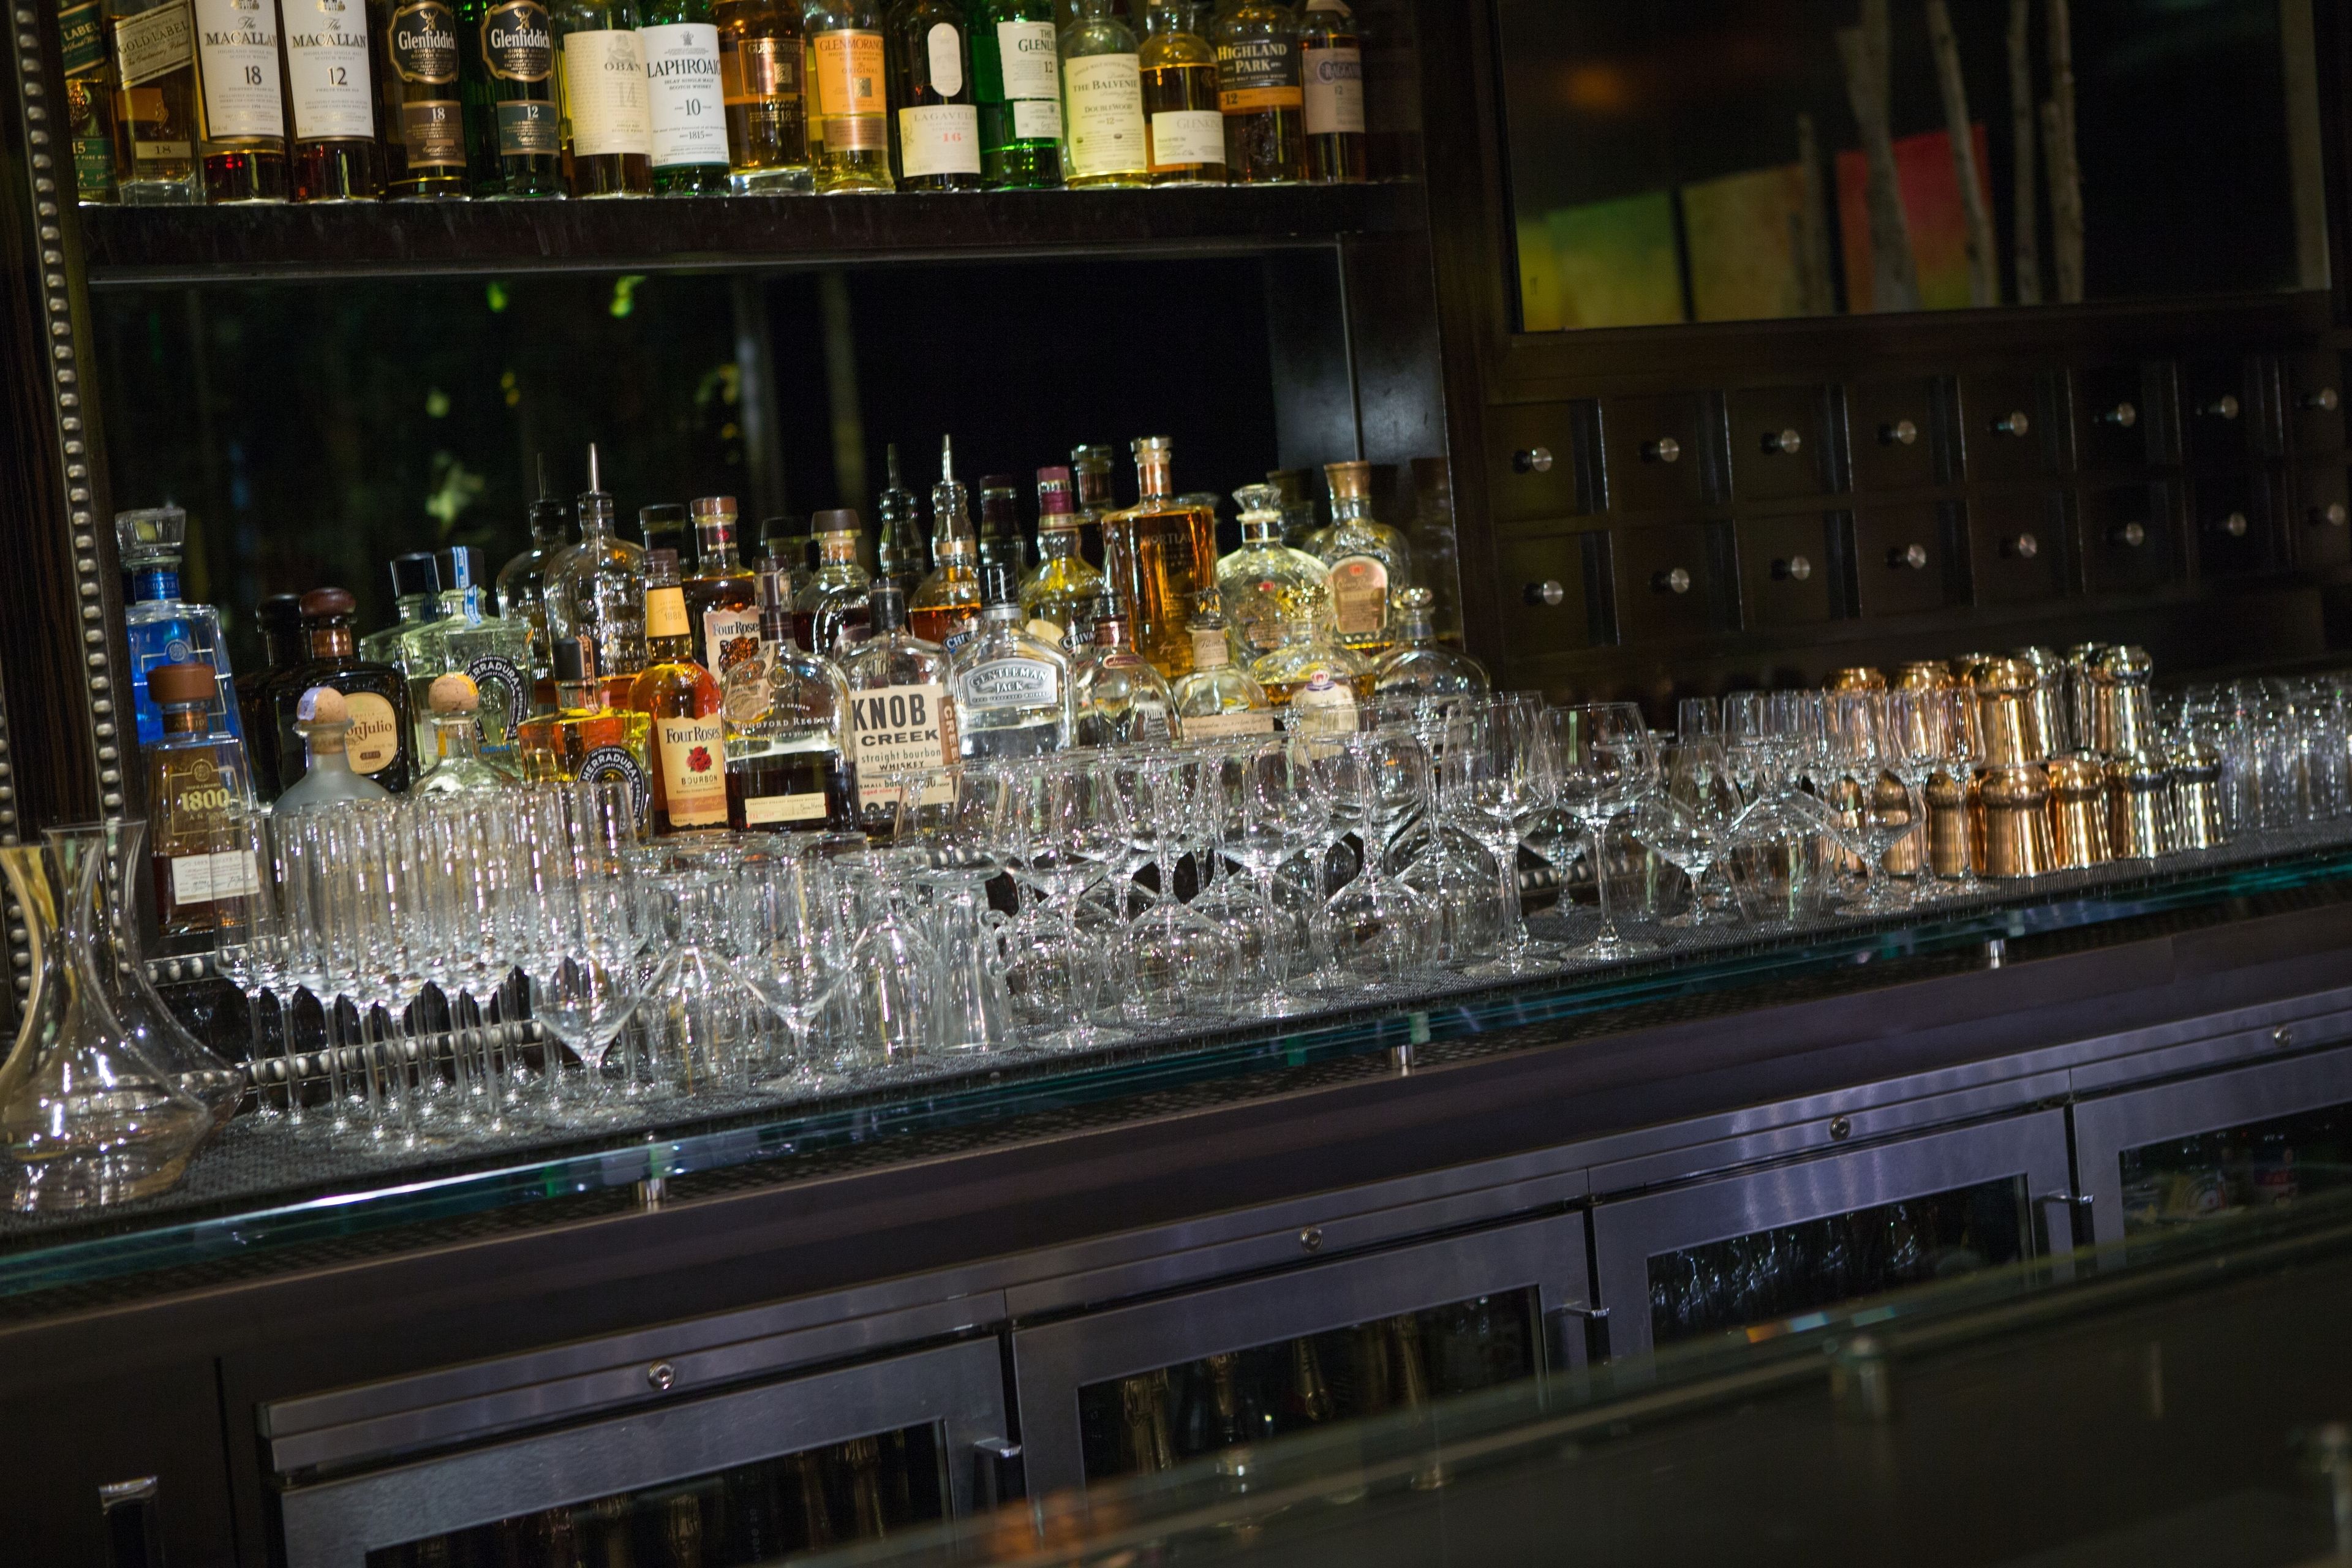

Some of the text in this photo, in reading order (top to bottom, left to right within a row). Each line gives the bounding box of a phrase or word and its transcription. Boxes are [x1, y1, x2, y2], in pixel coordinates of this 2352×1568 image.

[237, 15, 256, 29] The
[322, 17, 342, 31] The
[118, 36, 150, 54] GOLD
[153, 21, 189, 42] LABEL
[205, 32, 277, 48] MACALLAN
[292, 32, 367, 48] MACALLAN
[398, 29, 456, 50] Glenfiddich
[491, 28, 551, 48] Glenfiddich
[1040, 29, 1052, 39] THE
[1217, 43, 1287, 61] HIGHLAND
[605, 62, 641, 72] OBAN
[1044, 61, 1054, 73] 12
[1235, 59, 1271, 74] PARK
[244, 65, 263, 86] 18
[328, 67, 349, 86] 12
[1092, 79, 1137, 90] BALVENIE
[1335, 85, 1343, 95] 12
[618, 82, 637, 108] 14
[1225, 93, 1238, 105] 12
[432, 107, 446, 119] 18
[527, 105, 539, 119] 12
[685, 98, 701, 116] 10
[780, 110, 792, 121] 18
[688, 130, 706, 140] 1815
[943, 132, 962, 143] 16
[156, 146, 172, 154] 18
[664, 611, 682, 622] 1888
[712, 622, 736, 636] Four
[970, 667, 1048, 687] GENTLEMAN
[995, 681, 1023, 694] JACK
[851, 693, 927, 732] KNOB
[733, 715, 835, 729] WOODFORD RESERV
[363, 720, 393, 741] Julio
[666, 726, 720, 744] Four Roses
[861, 728, 940, 747] CREEK
[861, 747, 941, 764] straight bourbon
[582, 753, 637, 782] HERRADURA
[879, 760, 924, 771] WHISKEY
[681, 774, 718, 785] BOURBON
[179, 787, 230, 812] 1800
